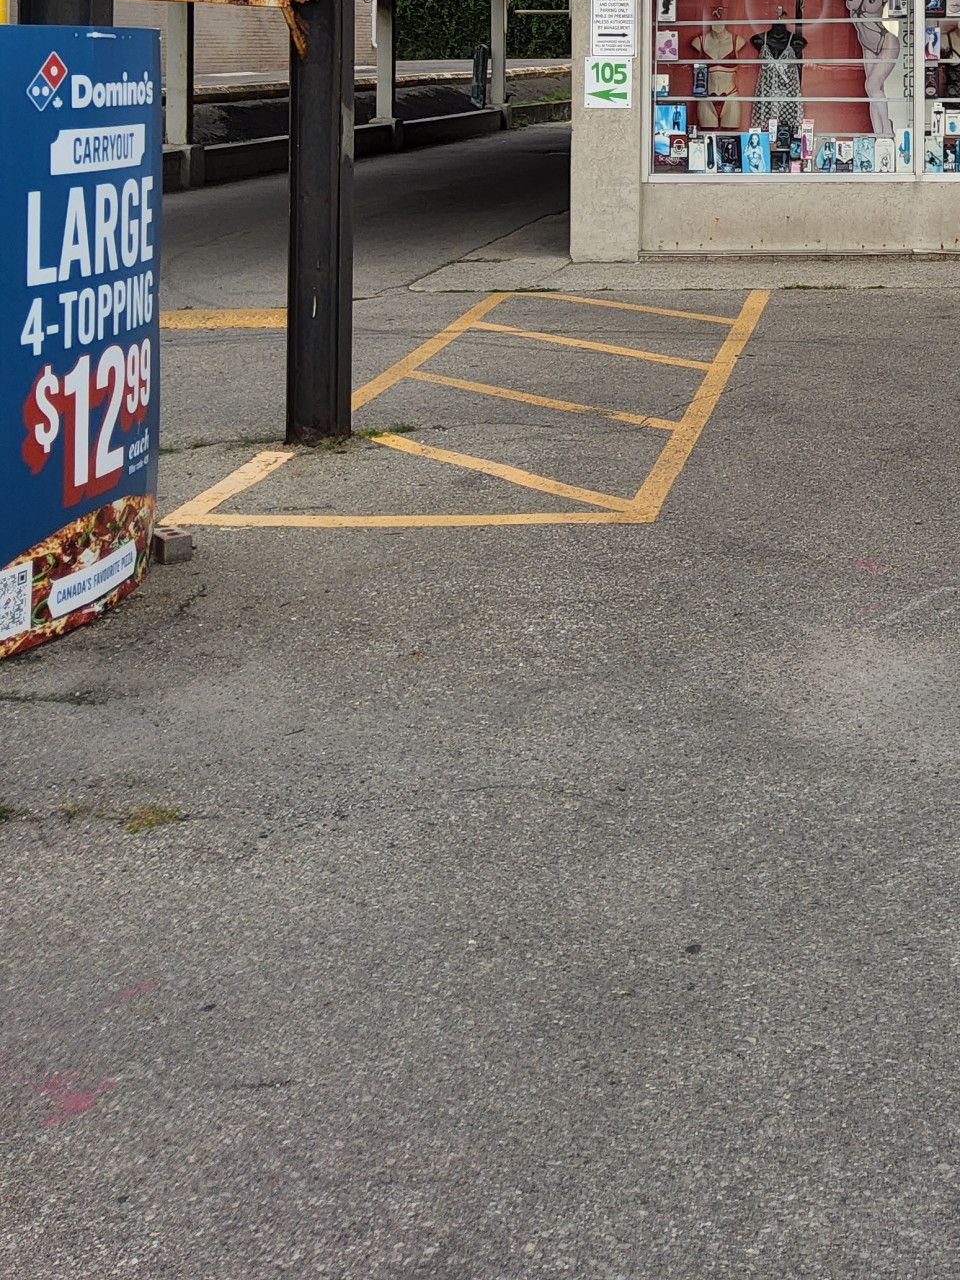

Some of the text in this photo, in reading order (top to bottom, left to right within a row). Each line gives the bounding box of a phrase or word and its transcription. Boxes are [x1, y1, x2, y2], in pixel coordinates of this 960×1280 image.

[71, 71, 154, 109] Domino's
[591, 62, 628, 85] 105
[72, 132, 135, 165] CARRYOUT
[26, 175, 154, 287] LARGE
[20, 270, 153, 357] 4-TOPPING
[128, 426, 150, 460] each
[56, 577, 92, 605] CANADA'S
